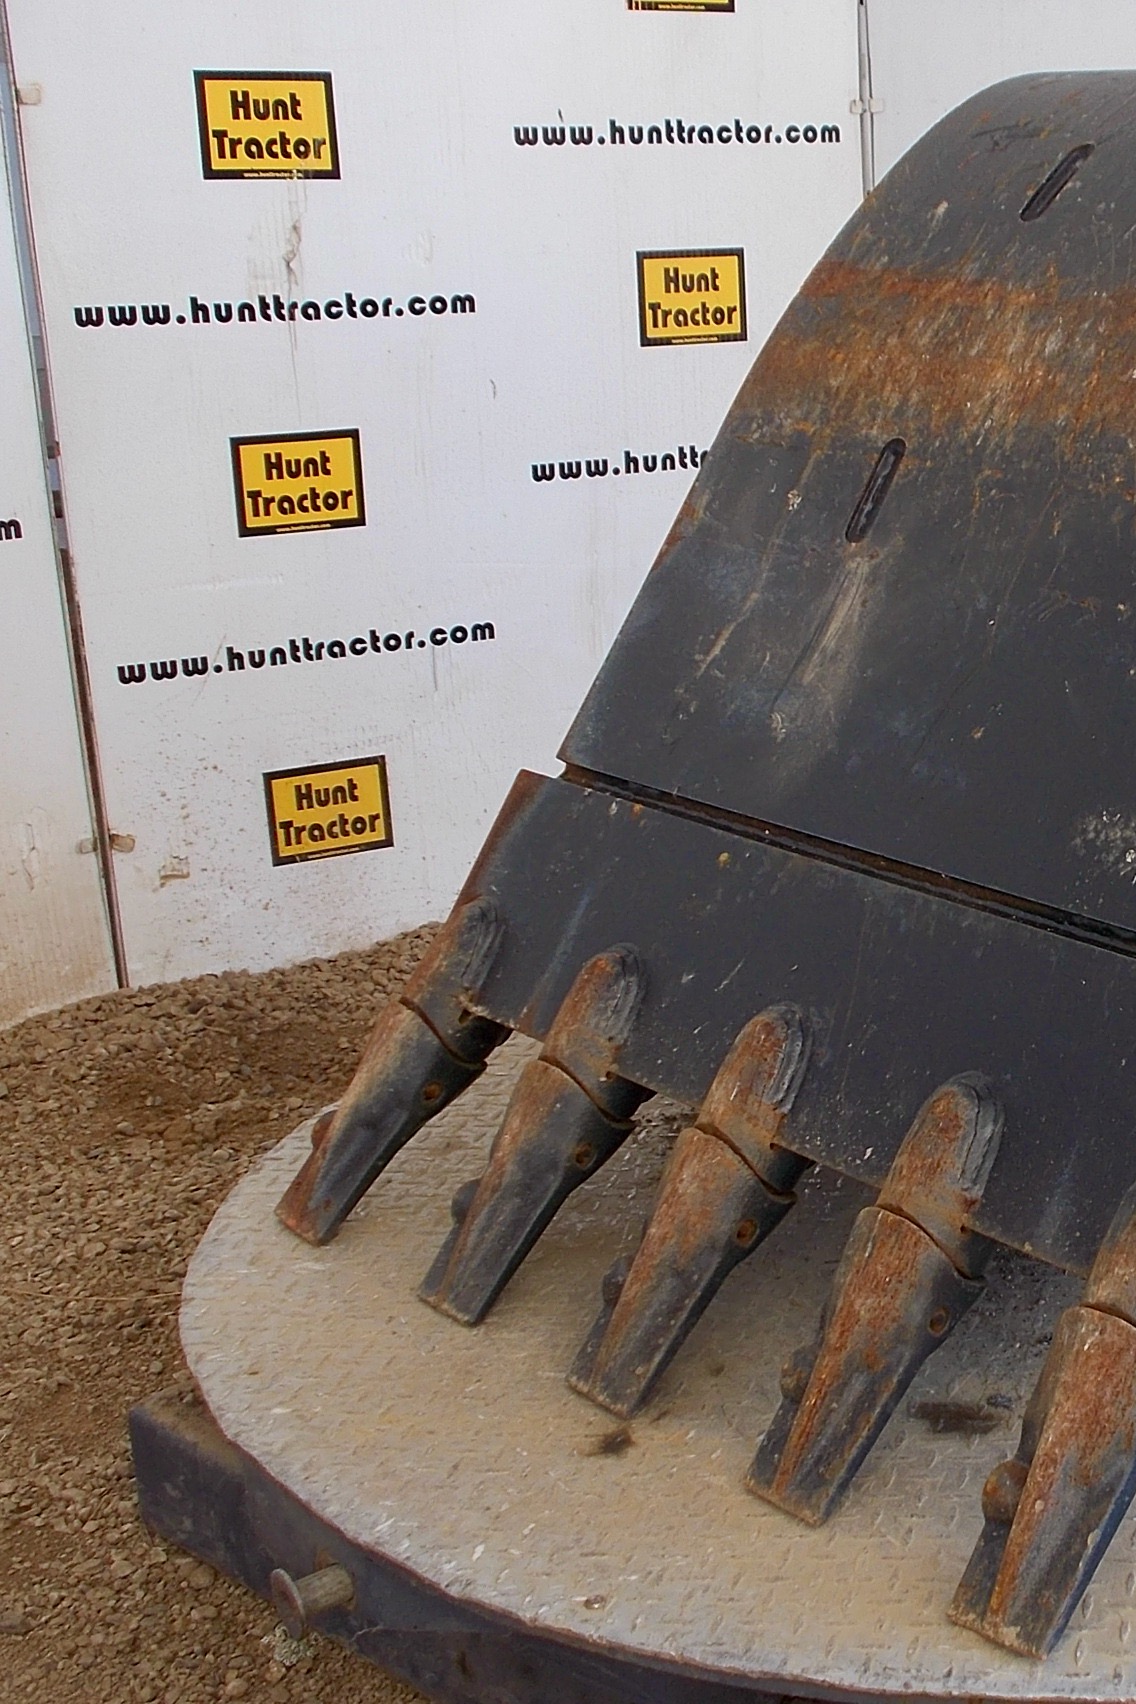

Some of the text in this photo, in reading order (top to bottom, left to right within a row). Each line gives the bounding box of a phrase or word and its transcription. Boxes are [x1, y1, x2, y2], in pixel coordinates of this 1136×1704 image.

[230, 90, 302, 121] Hunt
[212, 129, 326, 160] Tractor
[514, 118, 841, 146] www.hunttractor.com
[663, 267, 719, 294] Hunt
[74, 292, 477, 328] www.hunttractor.com
[648, 301, 738, 328] Tractor
[263, 450, 332, 481] Hunt
[246, 487, 353, 518] Tractor
[116, 621, 496, 685] www.hunttractor.com
[294, 778, 360, 811] Hunt
[278, 813, 381, 847] Tractor
